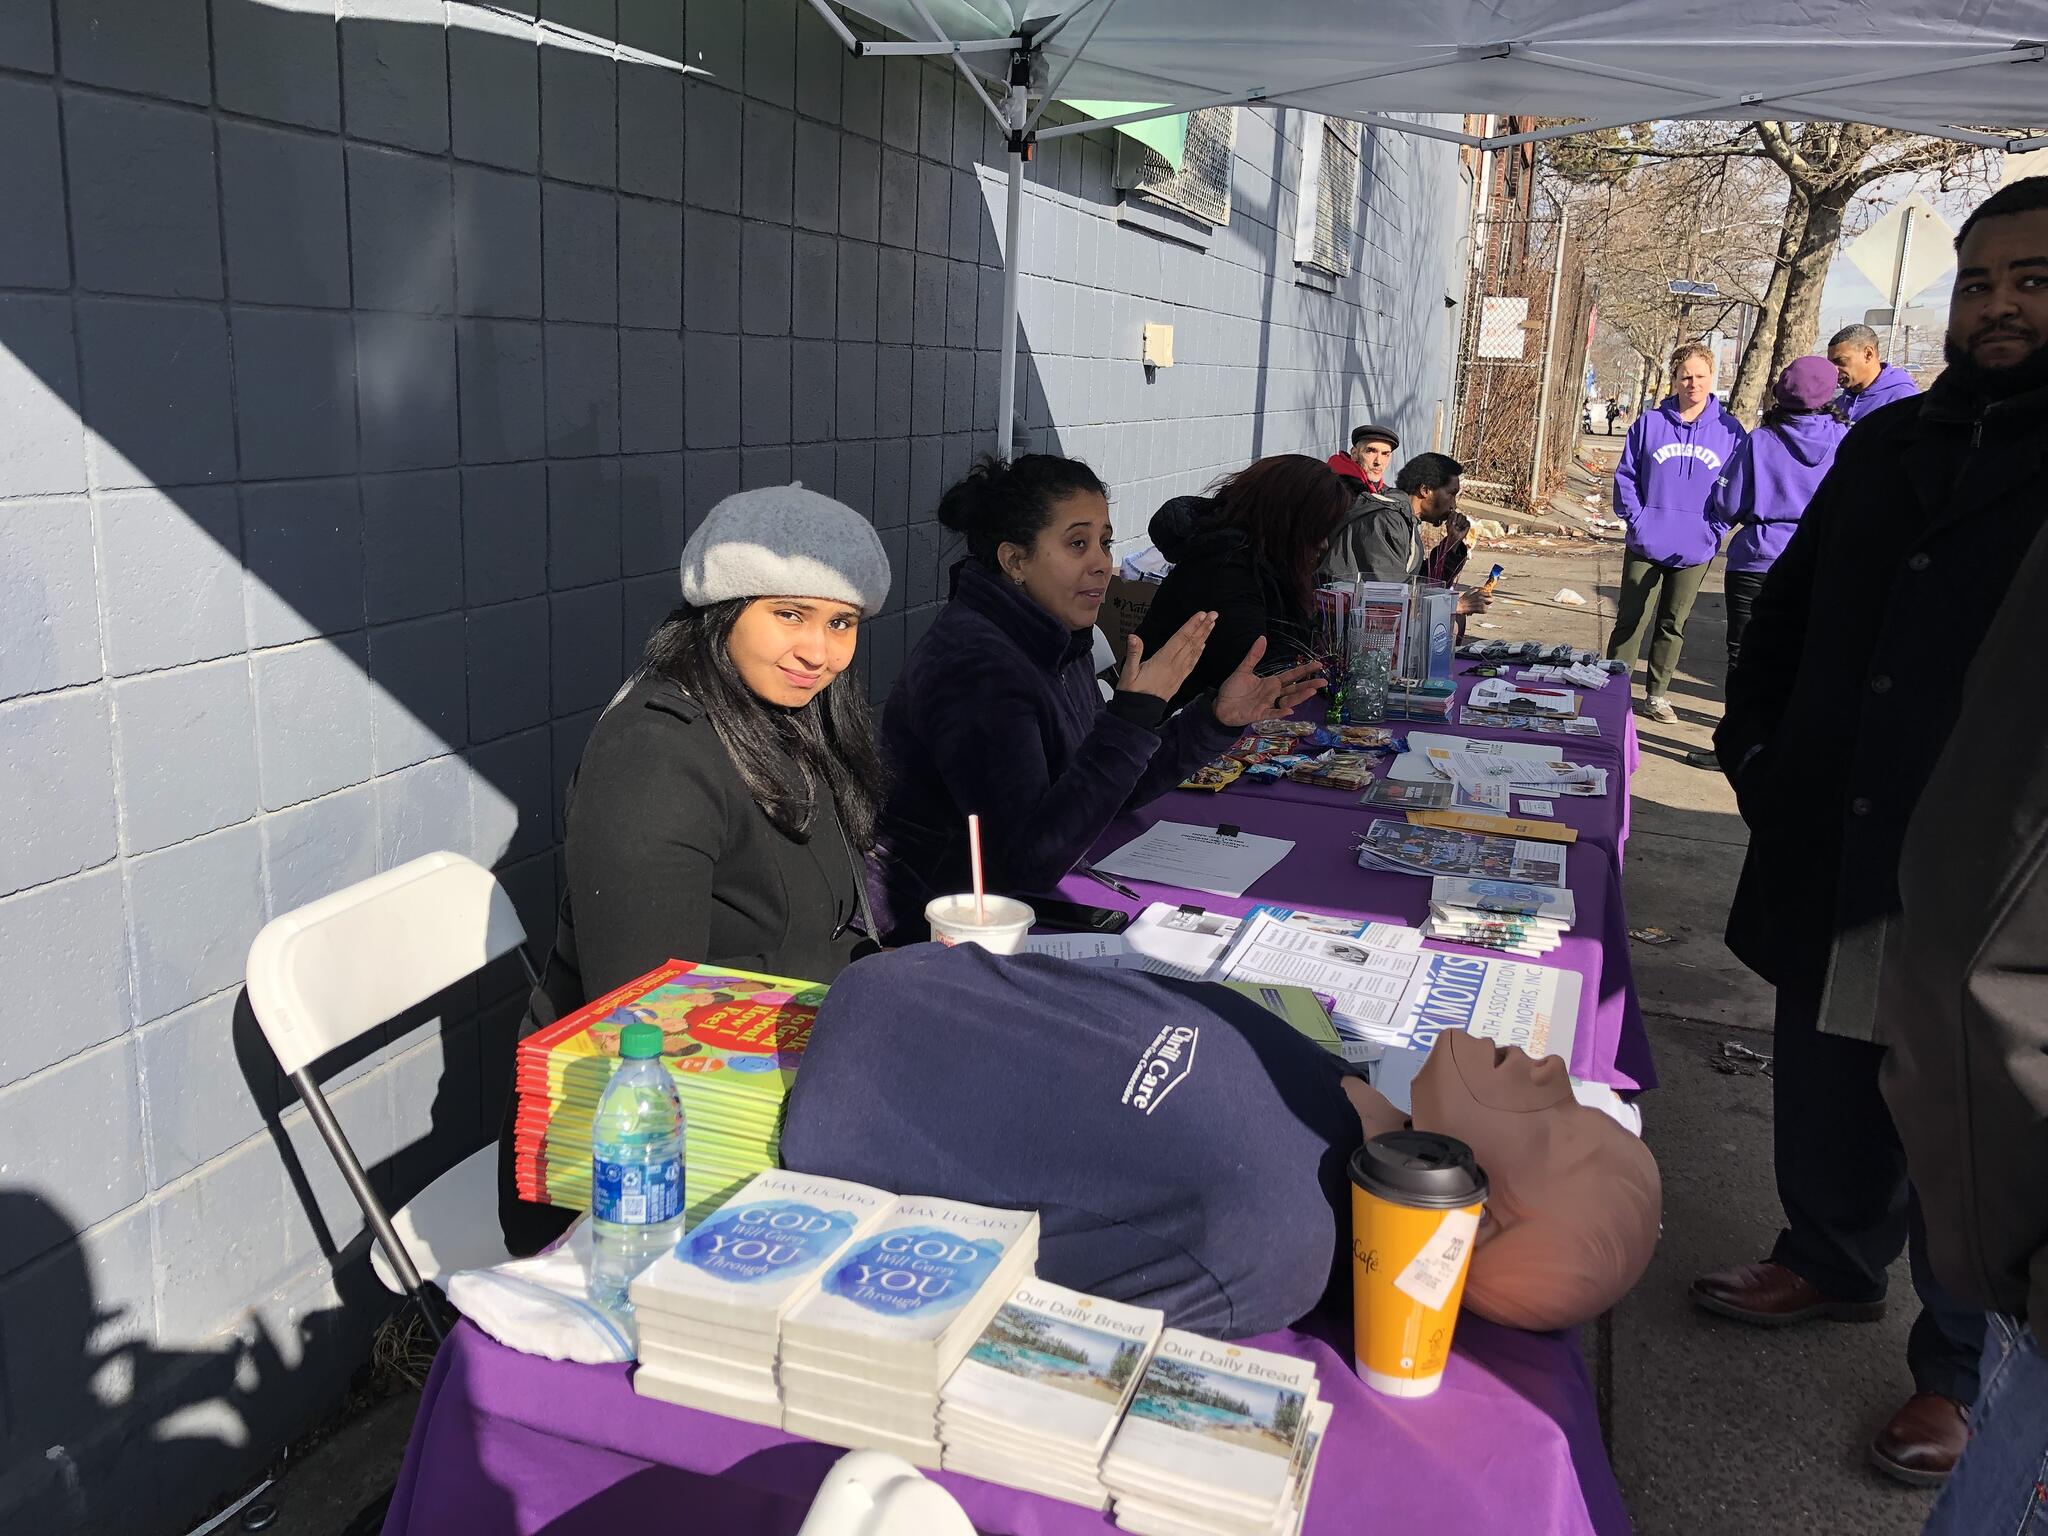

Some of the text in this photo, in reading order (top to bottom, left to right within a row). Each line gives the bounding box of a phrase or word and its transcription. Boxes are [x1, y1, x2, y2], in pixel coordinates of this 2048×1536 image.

[1653, 442, 1721, 470] INTEGRITY
[1488, 963, 1517, 1020] ASSOCIATION
[1523, 967, 1545, 987] INC.
[697, 1006, 744, 1030] Feel
[1515, 987, 1541, 1023] MORRIS,
[717, 1005, 774, 1036] How I
[736, 1009, 791, 1042] About
[1121, 1059, 1148, 1105] Connection
[1133, 1059, 1170, 1110] Care
[759, 1179, 876, 1206] MAX LUCADO
[738, 1207, 832, 1234] GOD
[896, 1204, 1018, 1231] MAX LUCADO
[708, 1234, 802, 1265] YOU
[731, 1223, 809, 1246] Will Carry
[881, 1234, 979, 1264] GOD
[703, 1254, 769, 1276] Through
[875, 1252, 958, 1277] Will Carry
[1352, 1238, 1379, 1275] Café
[855, 1264, 951, 1297] YOU
[853, 1284, 923, 1310] Through
[1015, 1290, 1145, 1337] Our Daily Bread
[1162, 1340, 1300, 1386] Our Daily Bread
